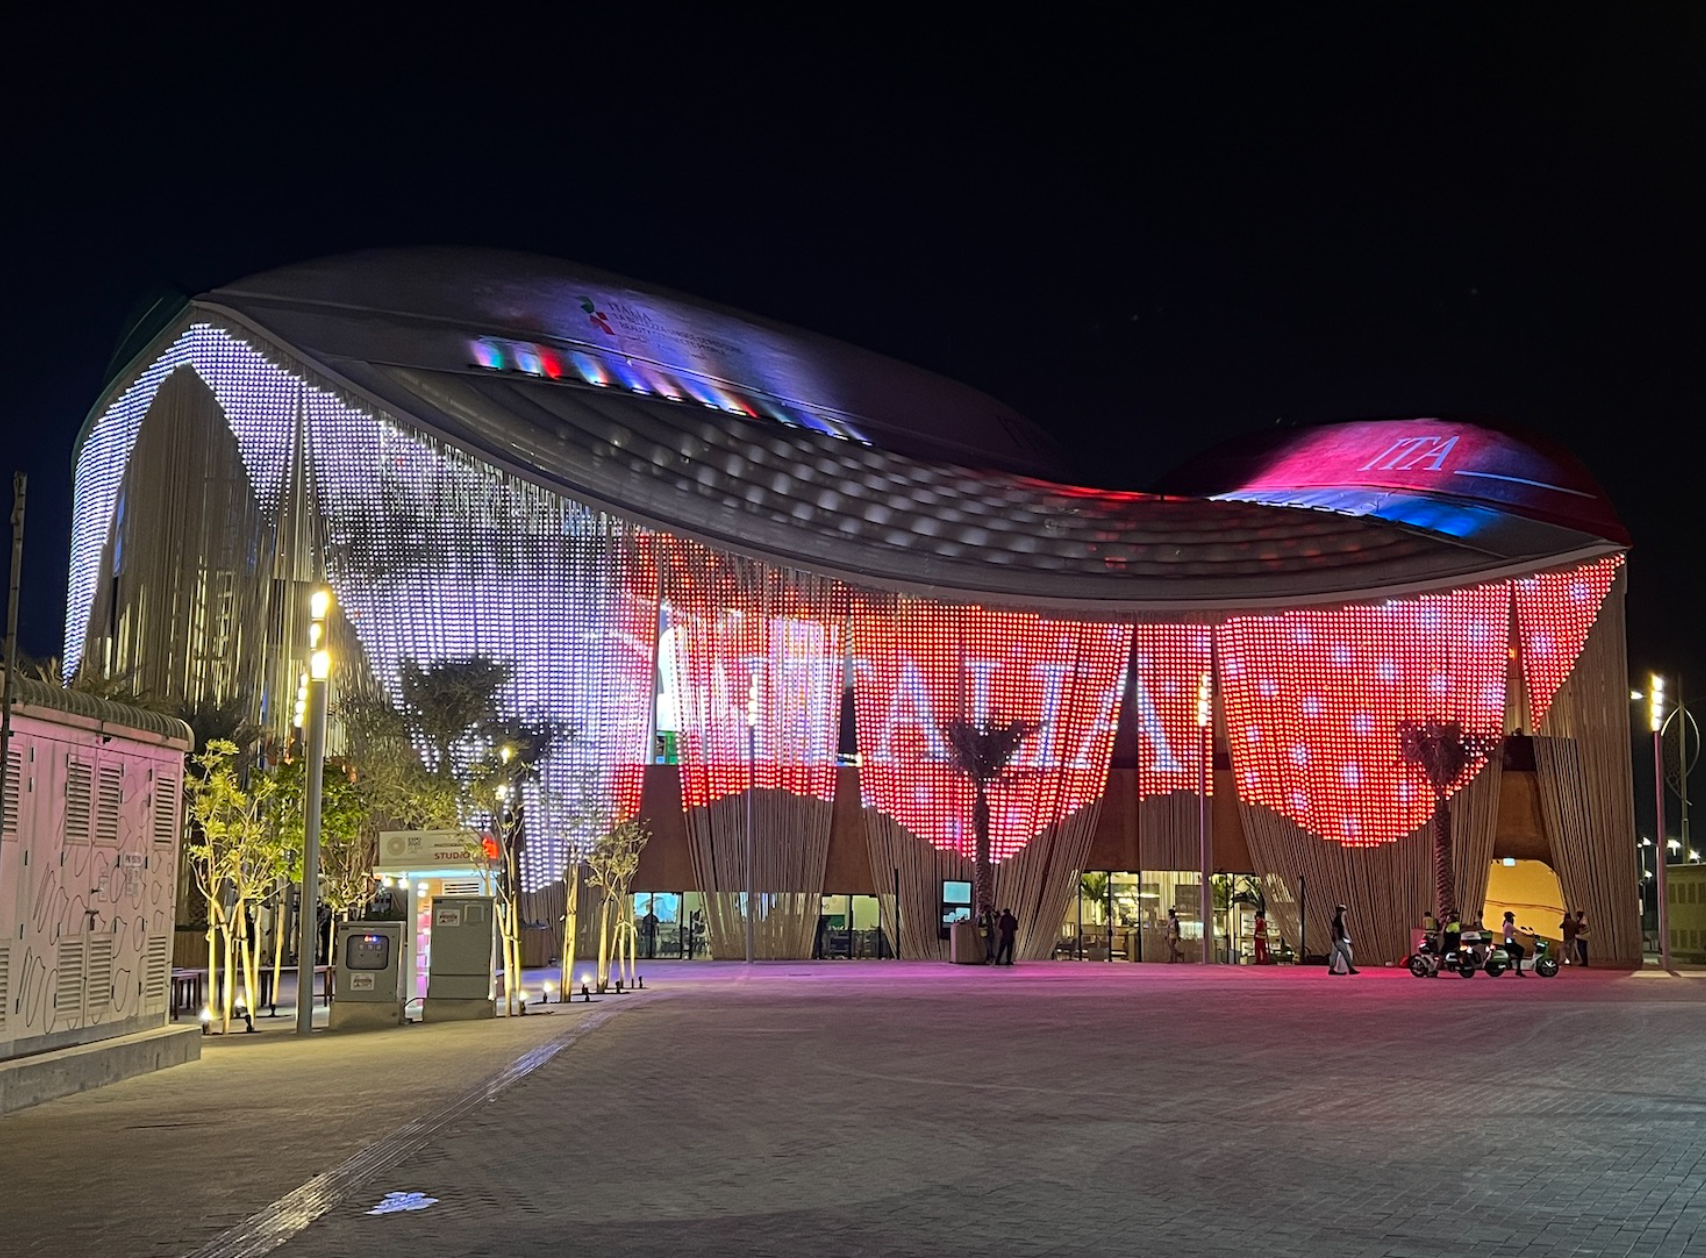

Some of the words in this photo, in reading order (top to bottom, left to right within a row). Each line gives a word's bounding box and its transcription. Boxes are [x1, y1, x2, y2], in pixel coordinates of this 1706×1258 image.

[1357, 436, 1459, 471] ITA
[738, 655, 1184, 773] ITALIA
[434, 852, 470, 860] STUDIO
